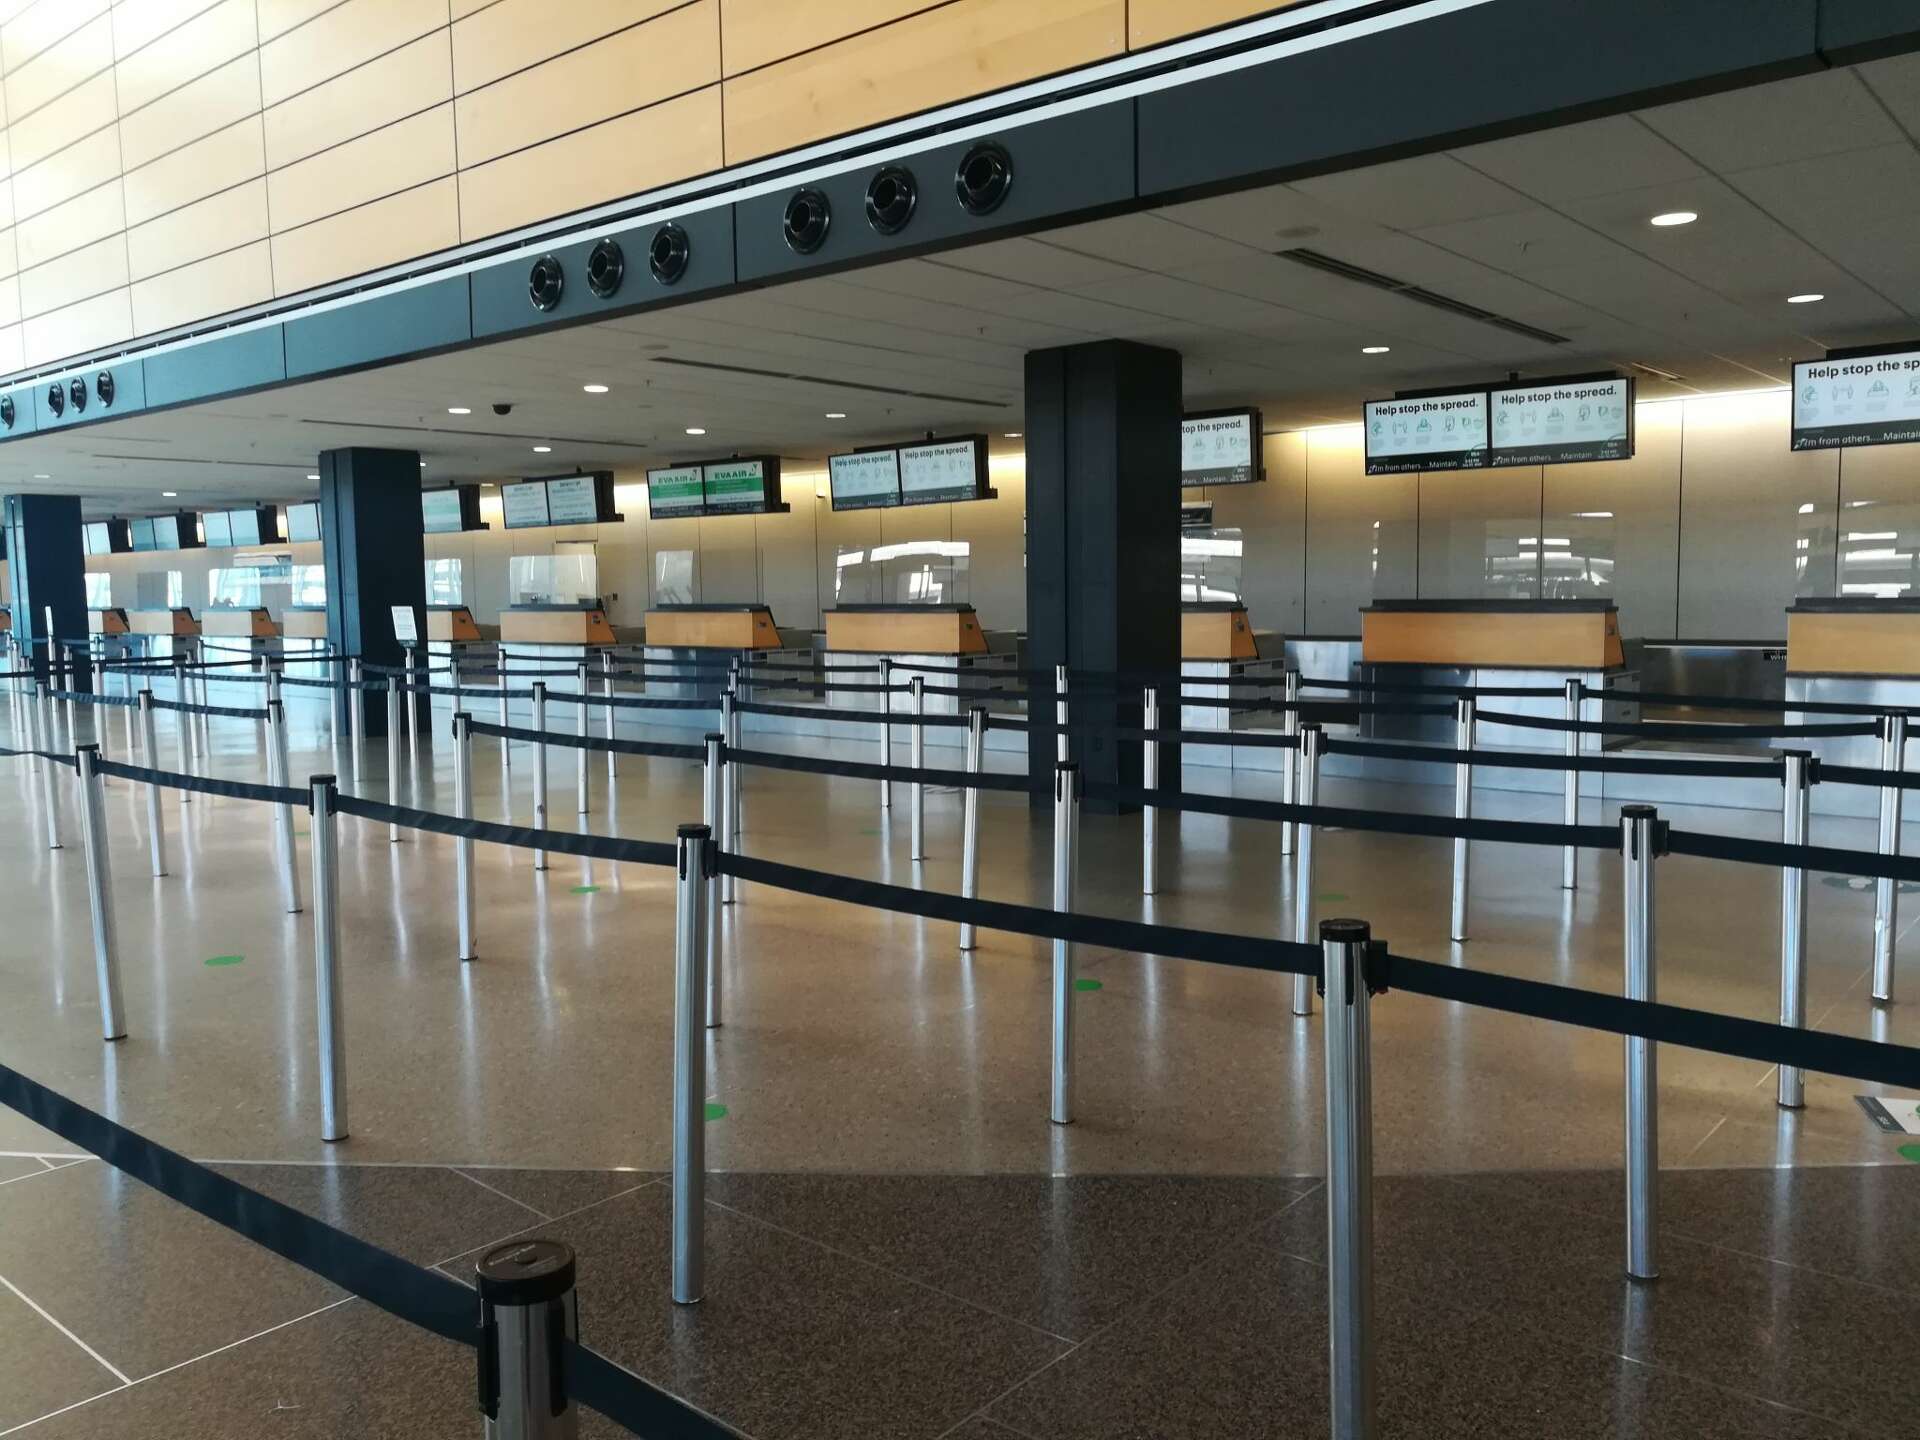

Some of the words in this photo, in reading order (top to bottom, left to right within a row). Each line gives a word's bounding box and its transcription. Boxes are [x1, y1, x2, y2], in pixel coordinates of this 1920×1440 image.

[1808, 366, 1839, 379] Help
[1842, 364, 1873, 375] stop
[1877, 360, 1900, 371] the
[1501, 393, 1525, 405] Help
[1527, 393, 1551, 403] stop
[1554, 390, 1571, 400] the
[1575, 384, 1617, 400] spread.
[1376, 405, 1397, 416] Help
[1399, 405, 1420, 414] stop
[1422, 401, 1439, 411] the
[1440, 397, 1479, 412] spread.
[1182, 425, 1196, 435] top
[1197, 423, 1211, 432] the
[1819, 437, 1840, 446] from
